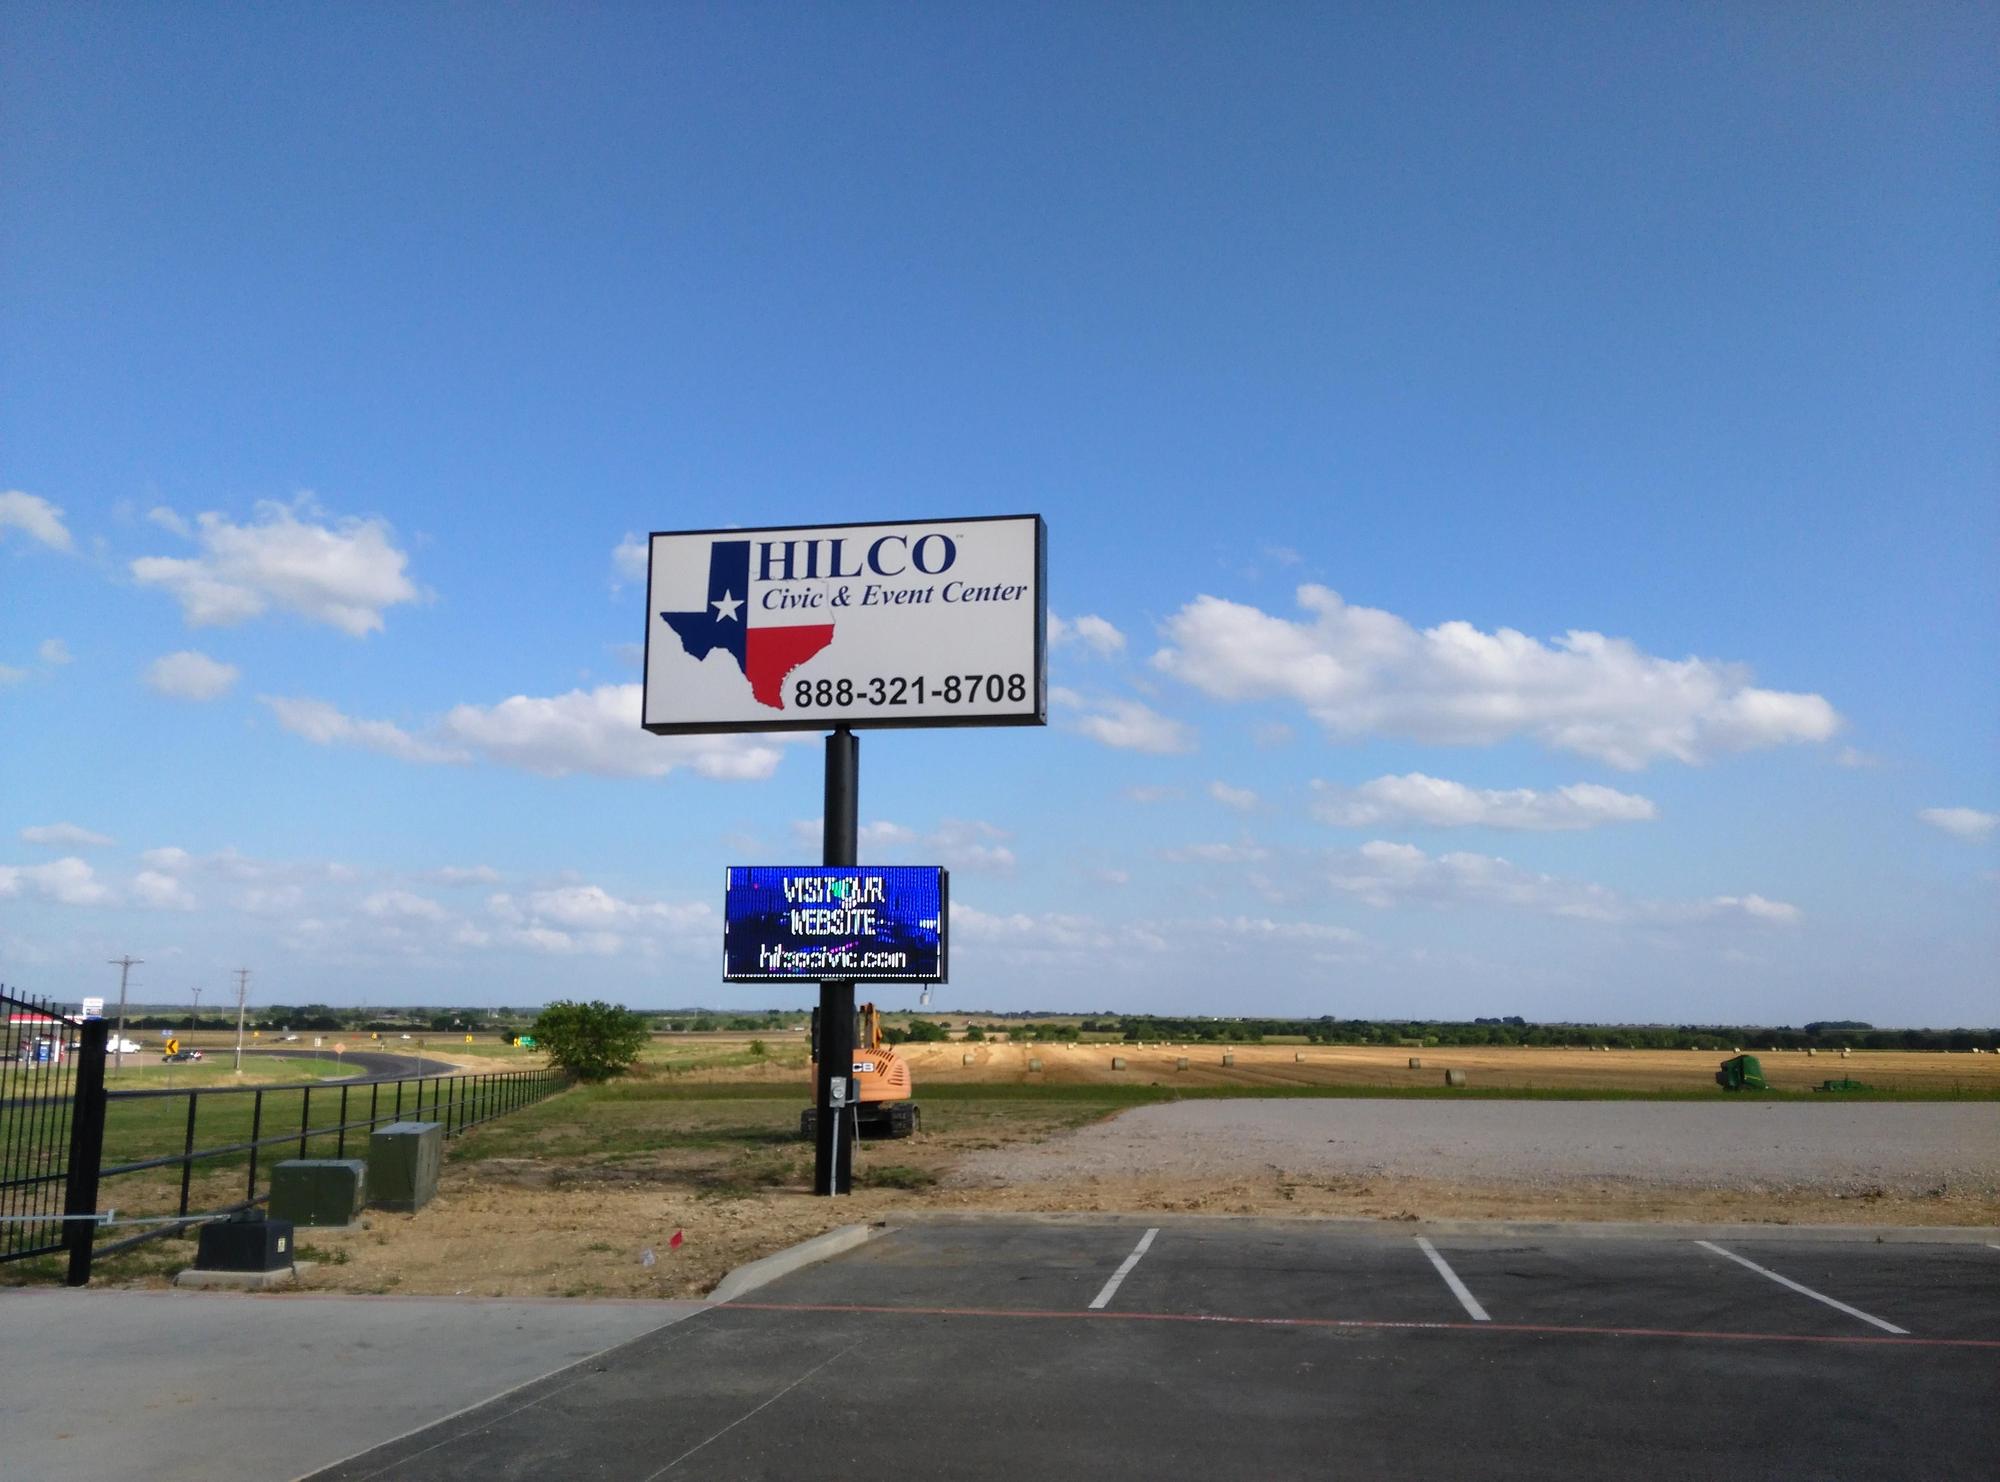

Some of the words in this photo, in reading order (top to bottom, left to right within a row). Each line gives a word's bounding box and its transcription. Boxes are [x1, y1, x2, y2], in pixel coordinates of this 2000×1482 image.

[754, 534, 956, 581] HILCO
[762, 587, 823, 610] Civic
[831, 585, 850, 607] &
[861, 585, 934, 606] Event
[942, 581, 1027, 603] Center
[795, 674, 1026, 708] 888-321-8708
[783, 877, 833, 903] VISIT
[791, 909, 876, 935] WEBSITE
[852, 1063, 874, 1073] CB
